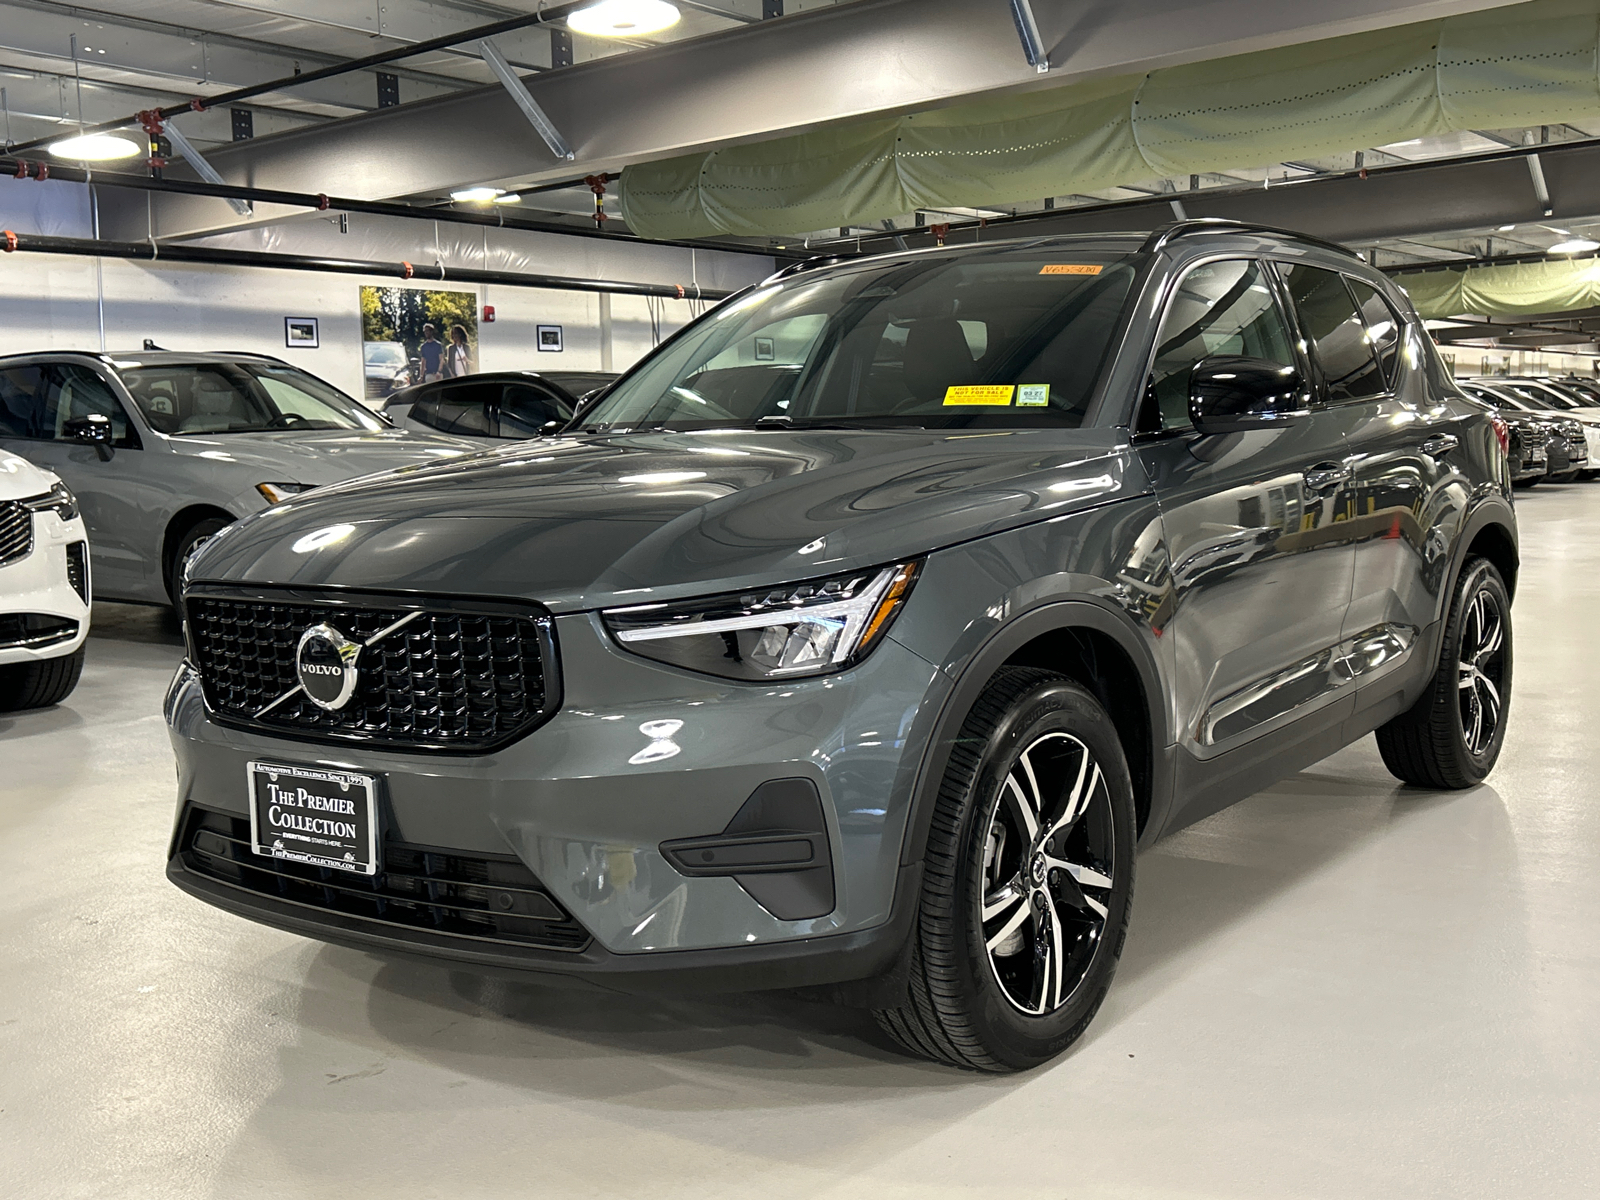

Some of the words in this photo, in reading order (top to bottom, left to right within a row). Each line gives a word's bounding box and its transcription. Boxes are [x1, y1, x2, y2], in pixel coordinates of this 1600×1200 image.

[301, 663, 342, 676] VOLVO
[346, 775, 363, 785] 1995
[282, 832, 312, 843] EVERYTHING
[311, 836, 329, 846] STARTS
